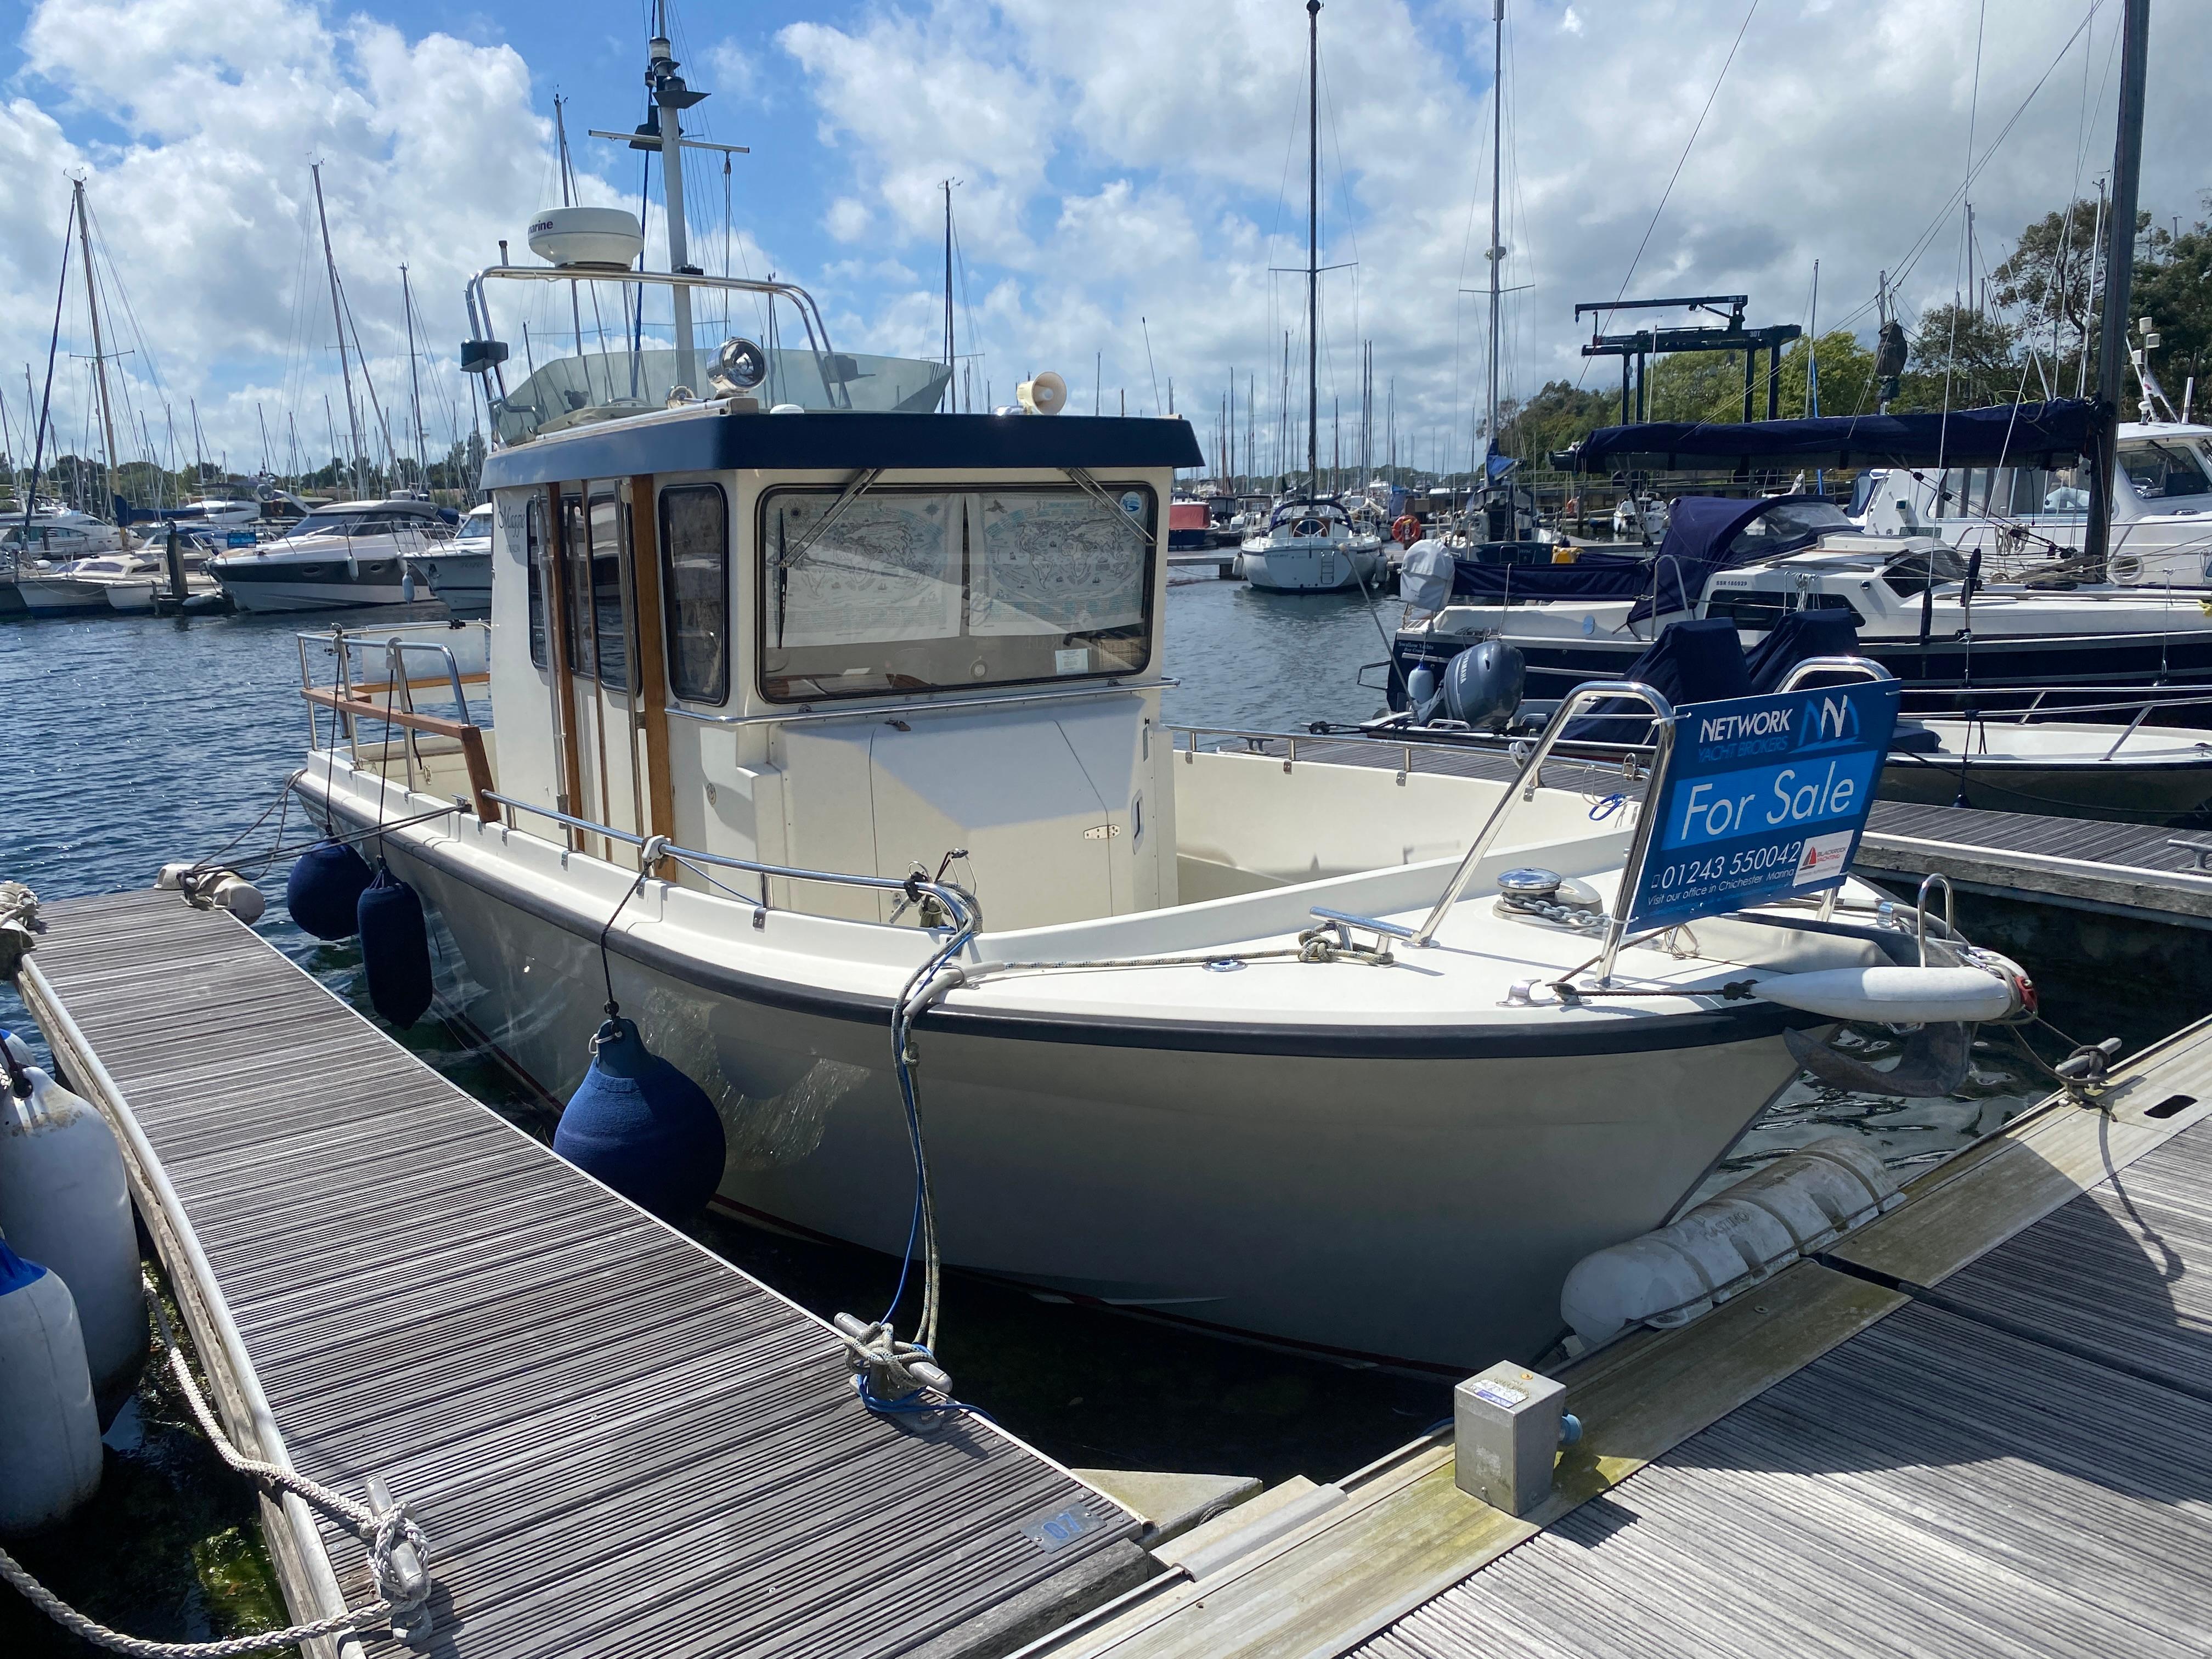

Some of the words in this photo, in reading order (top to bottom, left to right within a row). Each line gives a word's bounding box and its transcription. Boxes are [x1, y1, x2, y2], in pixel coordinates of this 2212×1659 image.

[1460, 656, 1470, 685] YAMAHA
[1699, 708, 1793, 743] NETWORK
[1698, 742, 1737, 763] YACHT
[1737, 735, 1788, 757] BROKERS
[1681, 783, 1756, 840] For
[1766, 761, 1854, 824] Sale
[1662, 856, 1725, 889] 01243
[1729, 841, 1801, 875] 550042
[1648, 894, 1666, 906] Visit
[1666, 893, 1681, 902] our
[1683, 887, 1707, 900] office
[1708, 883, 1716, 894] in
[1719, 875, 1763, 891] Chichester
[1766, 868, 1795, 882] Marina
